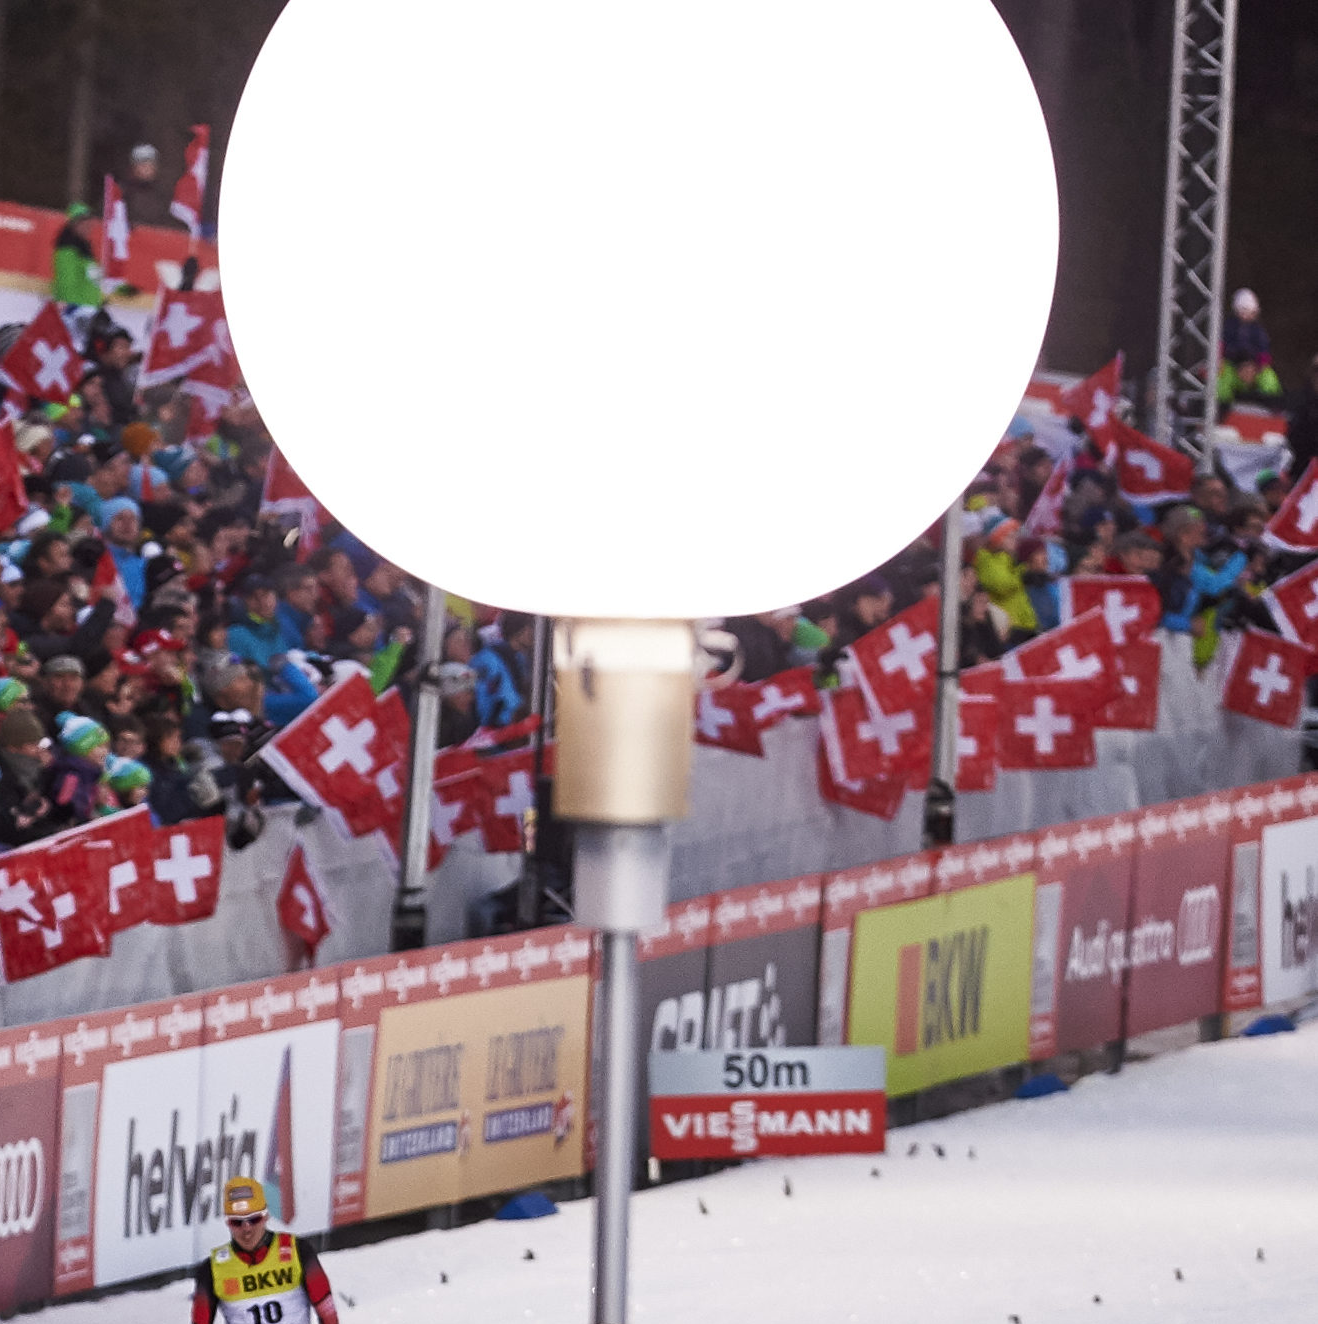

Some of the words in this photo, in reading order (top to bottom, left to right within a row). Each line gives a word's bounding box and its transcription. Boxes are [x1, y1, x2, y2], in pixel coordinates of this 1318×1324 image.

[723, 1054, 810, 1089] 50m
[663, 1100, 871, 1153] VIESSMANN
[243, 1266, 293, 1293] BKW
